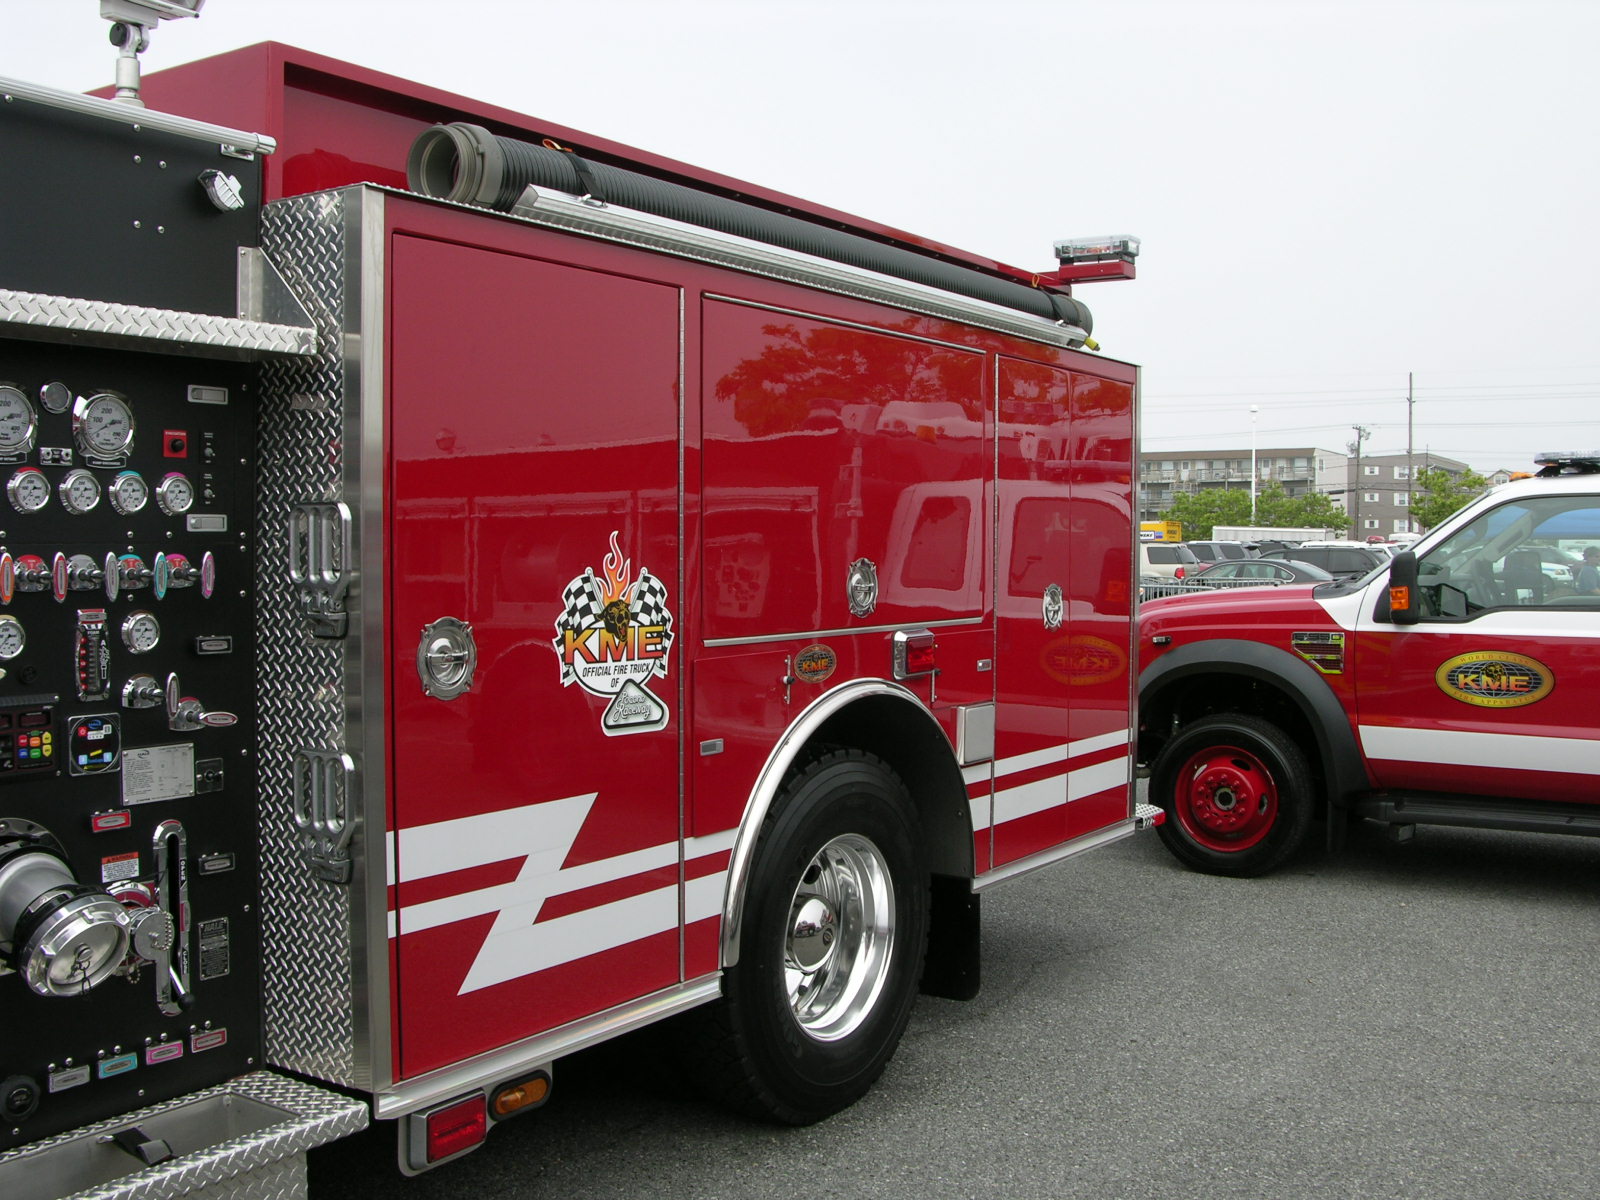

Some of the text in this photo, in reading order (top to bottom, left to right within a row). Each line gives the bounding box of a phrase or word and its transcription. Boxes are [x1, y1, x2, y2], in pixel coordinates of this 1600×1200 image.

[564, 625, 665, 666] KME
[582, 662, 651, 677] OFFICIAL FIRE TRUCK
[803, 658, 829, 672] KME
[610, 678, 620, 688] OF
[1458, 673, 1530, 691] KME
